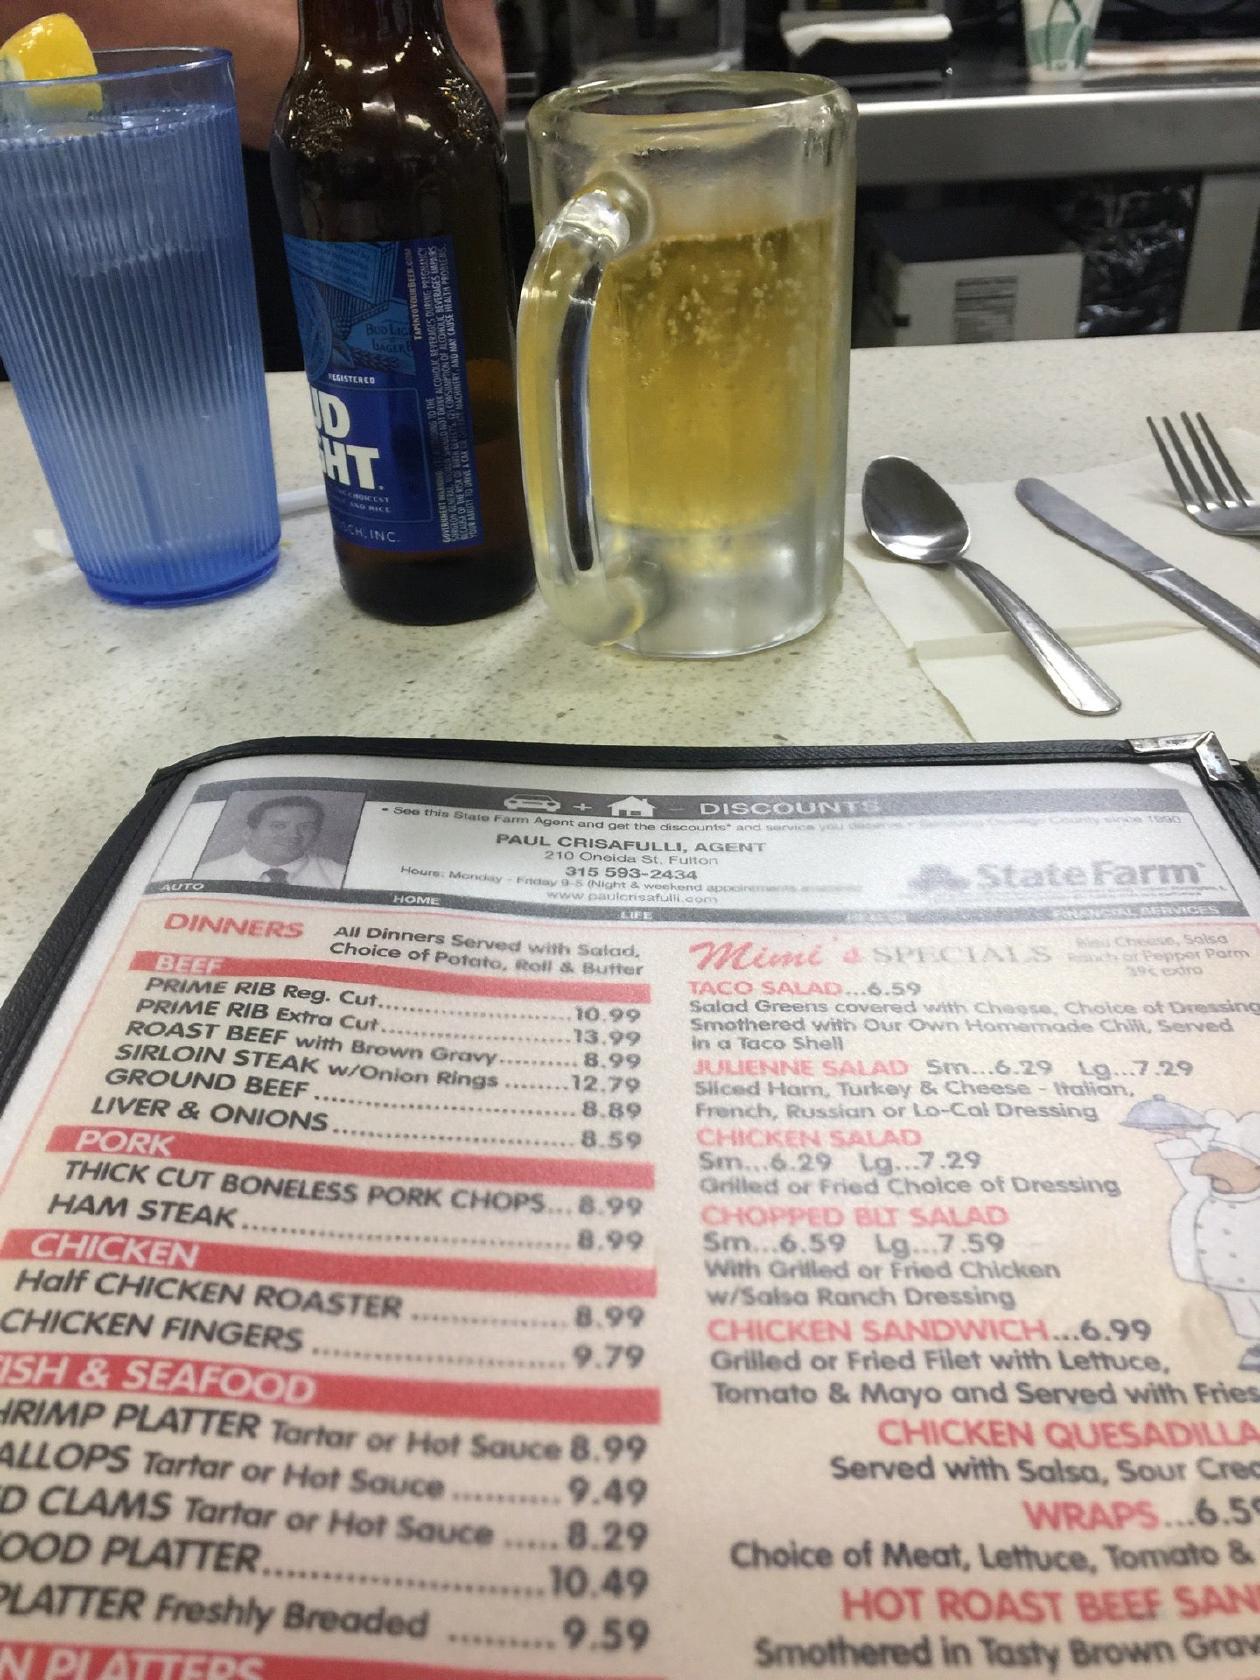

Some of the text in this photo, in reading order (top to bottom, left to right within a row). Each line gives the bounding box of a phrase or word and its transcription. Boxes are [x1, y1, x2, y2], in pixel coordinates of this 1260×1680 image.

[328, 373, 375, 384] REGISTERED
[319, 436, 380, 490] HT
[393, 806, 420, 816] See
[424, 808, 449, 818] this
[453, 811, 490, 822] State
[493, 814, 529, 825] Farm
[534, 816, 574, 828] Agent
[577, 819, 604, 830] and
[609, 822, 630, 833] get
[634, 822, 656, 831] the
[699, 801, 881, 816] DISCOUNTS
[495, 833, 552, 847] PAUL
[695, 842, 767, 853] AGENT
[544, 850, 719, 866] 210 Oneida St. Fulton
[159, 882, 205, 893] AUTO
[565, 866, 698, 880] 315 593-2434
[393, 894, 440, 906] HOME
[620, 909, 653, 921] LIFE
[163, 912, 305, 940] DINNERS
[333, 925, 361, 938] All
[366, 927, 445, 945] Dinners
[450, 933, 521, 952] Served
[527, 941, 571, 957] with
[154, 953, 225, 976] BEEF
[329, 941, 644, 977] Choice Potato, Roll Butter
[872, 945, 1053, 965] SPECIALS
[145, 976, 642, 1023] PRIME RIB Reg. Cut 10.99
[688, 980, 754, 996] TACO
[761, 980, 844, 996] SALAD
[689, 999, 749, 1014] Salad
[754, 1000, 829, 1014] Greens
[834, 1000, 918, 1015] covered
[1064, 1001, 1138, 1016] Choice
[276, 1007, 642, 1046] Extra 13.99
[690, 1017, 805, 1033] Smothered
[863, 1018, 901, 1032] Our
[908, 1018, 960, 1032] Own
[966, 1019, 1095, 1034] Homemade
[1158, 1018, 1235, 1034] Served
[124, 1020, 642, 1069] ROAST Brown Gravy 8.99
[739, 1035, 844, 1052] Taco Shell
[114, 1043, 642, 1093] SIRLOIN STEAK w/Onion Rings 12.79
[692, 1059, 815, 1077] JULIENNE
[104, 1067, 643, 1120] GROUND 8.89
[694, 1081, 761, 1097] Sliced
[767, 1081, 831, 1100] Ham,
[837, 1081, 912, 1100] Turkey
[944, 1080, 1032, 1097] Cheese
[90, 1095, 643, 1150] LIVER & ONIONS 8.59
[694, 1102, 778, 1121] French,
[786, 1102, 876, 1119] Russian
[74, 1129, 177, 1158] PORK
[64, 1159, 547, 1215] THICK CUT BONELESS CHOPS
[699, 1175, 880, 1196] Grilled Fried
[46, 1193, 129, 1219] HAM
[700, 1205, 900, 1228] CHOPPED BLT
[30, 1232, 201, 1269] CHICKEN
[703, 1259, 1062, 1280] With Chicken
[14, 1268, 404, 1319] Half ROASTER
[705, 1285, 900, 1307] w/Salsa Ranch
[161, 1315, 646, 1370] FINGERS 9.79
[862, 1318, 1050, 1343] SANDWICH
[924, 1349, 1171, 1375] Filet Lettuce,
[120, 1358, 318, 1404] SEAFOOD
[711, 1380, 1260, 1410] Tomato Mayo Fries
[112, 1403, 564, 1462] PLATTER Tartar Hot Sauce
[1044, 1418, 1260, 1451] QUESADILLA
[1017, 1456, 1187, 1487] Salsa, Sour
[566, 1474, 649, 1507] 9.49
[38, 1485, 650, 1552] CLAMS 8.29
[1022, 1499, 1161, 1531] WRAPS
[882, 1540, 970, 1574] Meat,
[548, 1564, 650, 1600] 10.49
[839, 1586, 928, 1624] HOT
[154, 1592, 651, 1652] Freshly Breaded 9.59
[941, 1634, 1061, 1676] in Tasty
